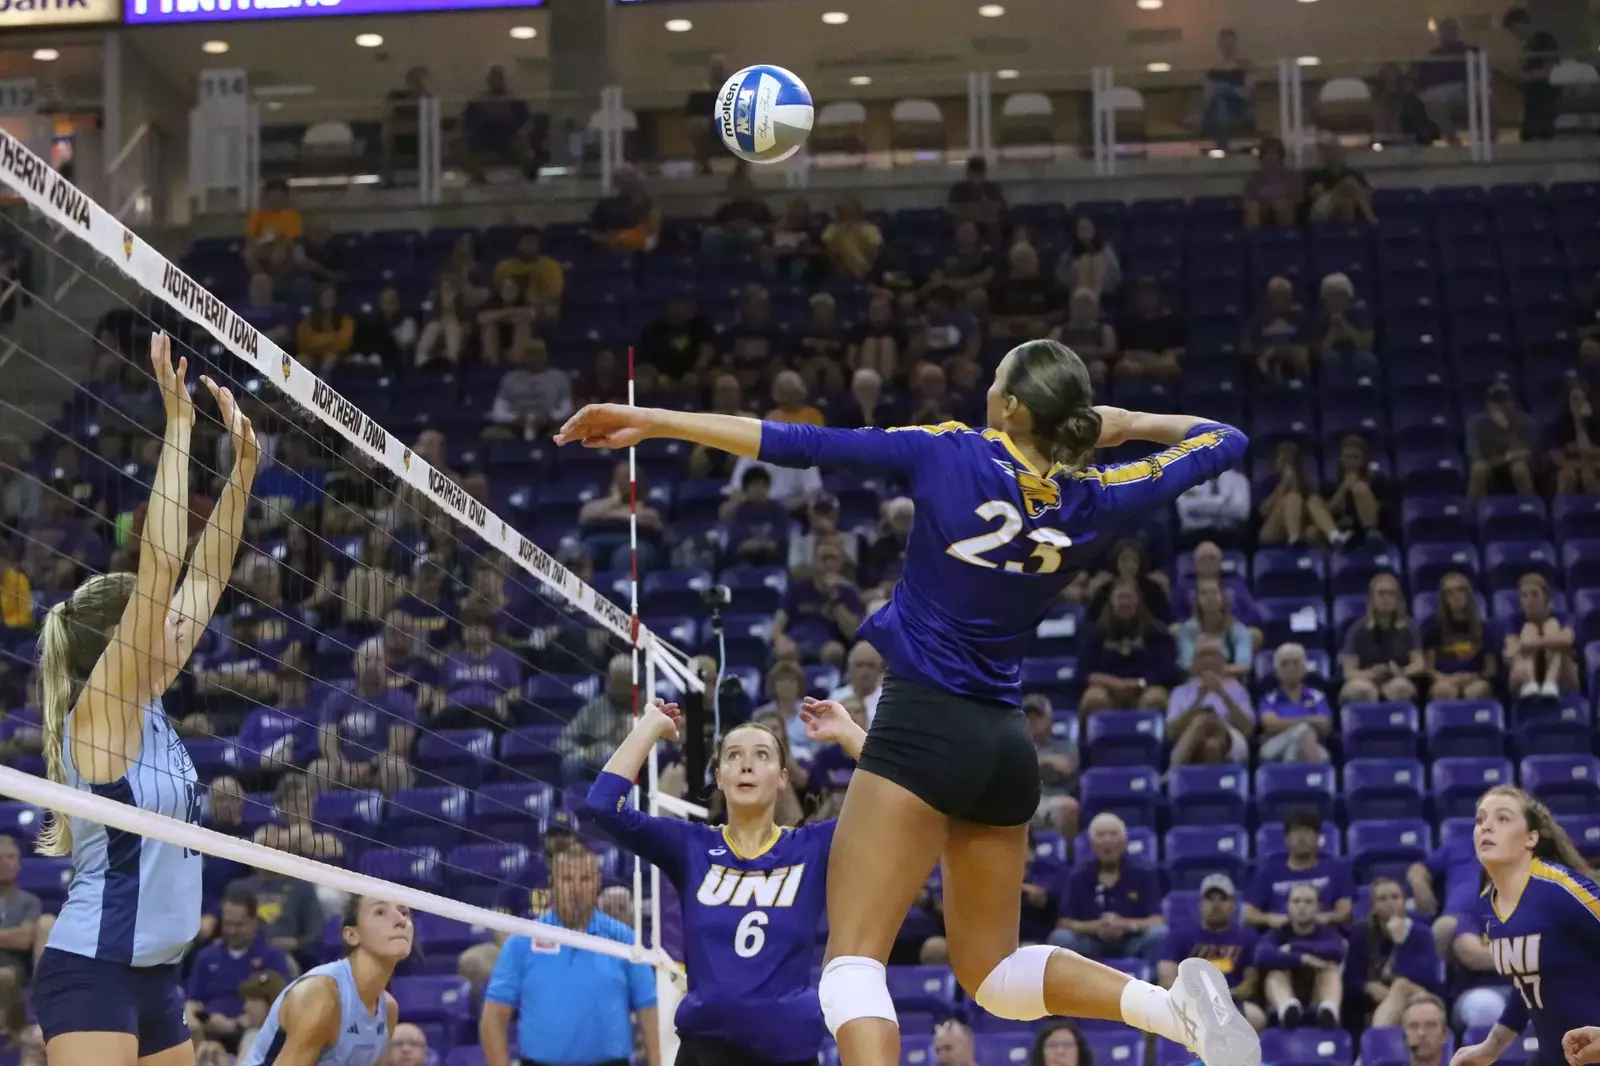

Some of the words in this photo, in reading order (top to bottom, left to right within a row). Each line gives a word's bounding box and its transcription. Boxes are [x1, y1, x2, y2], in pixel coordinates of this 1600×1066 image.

[722, 83, 739, 137] molten
[50, 175, 91, 230] IOWA
[162, 262, 228, 334] NORTHERN
[228, 315, 259, 360] IOWA
[312, 377, 362, 437] NORTHERN
[362, 415, 387, 454] IOWA
[428, 466, 467, 515] NORTHERN
[467, 496, 486, 529] IOWA
[945, 500, 1072, 573] 23
[697, 863, 806, 906] UNI
[734, 910, 769, 958] 6
[1489, 933, 1542, 976] UNI
